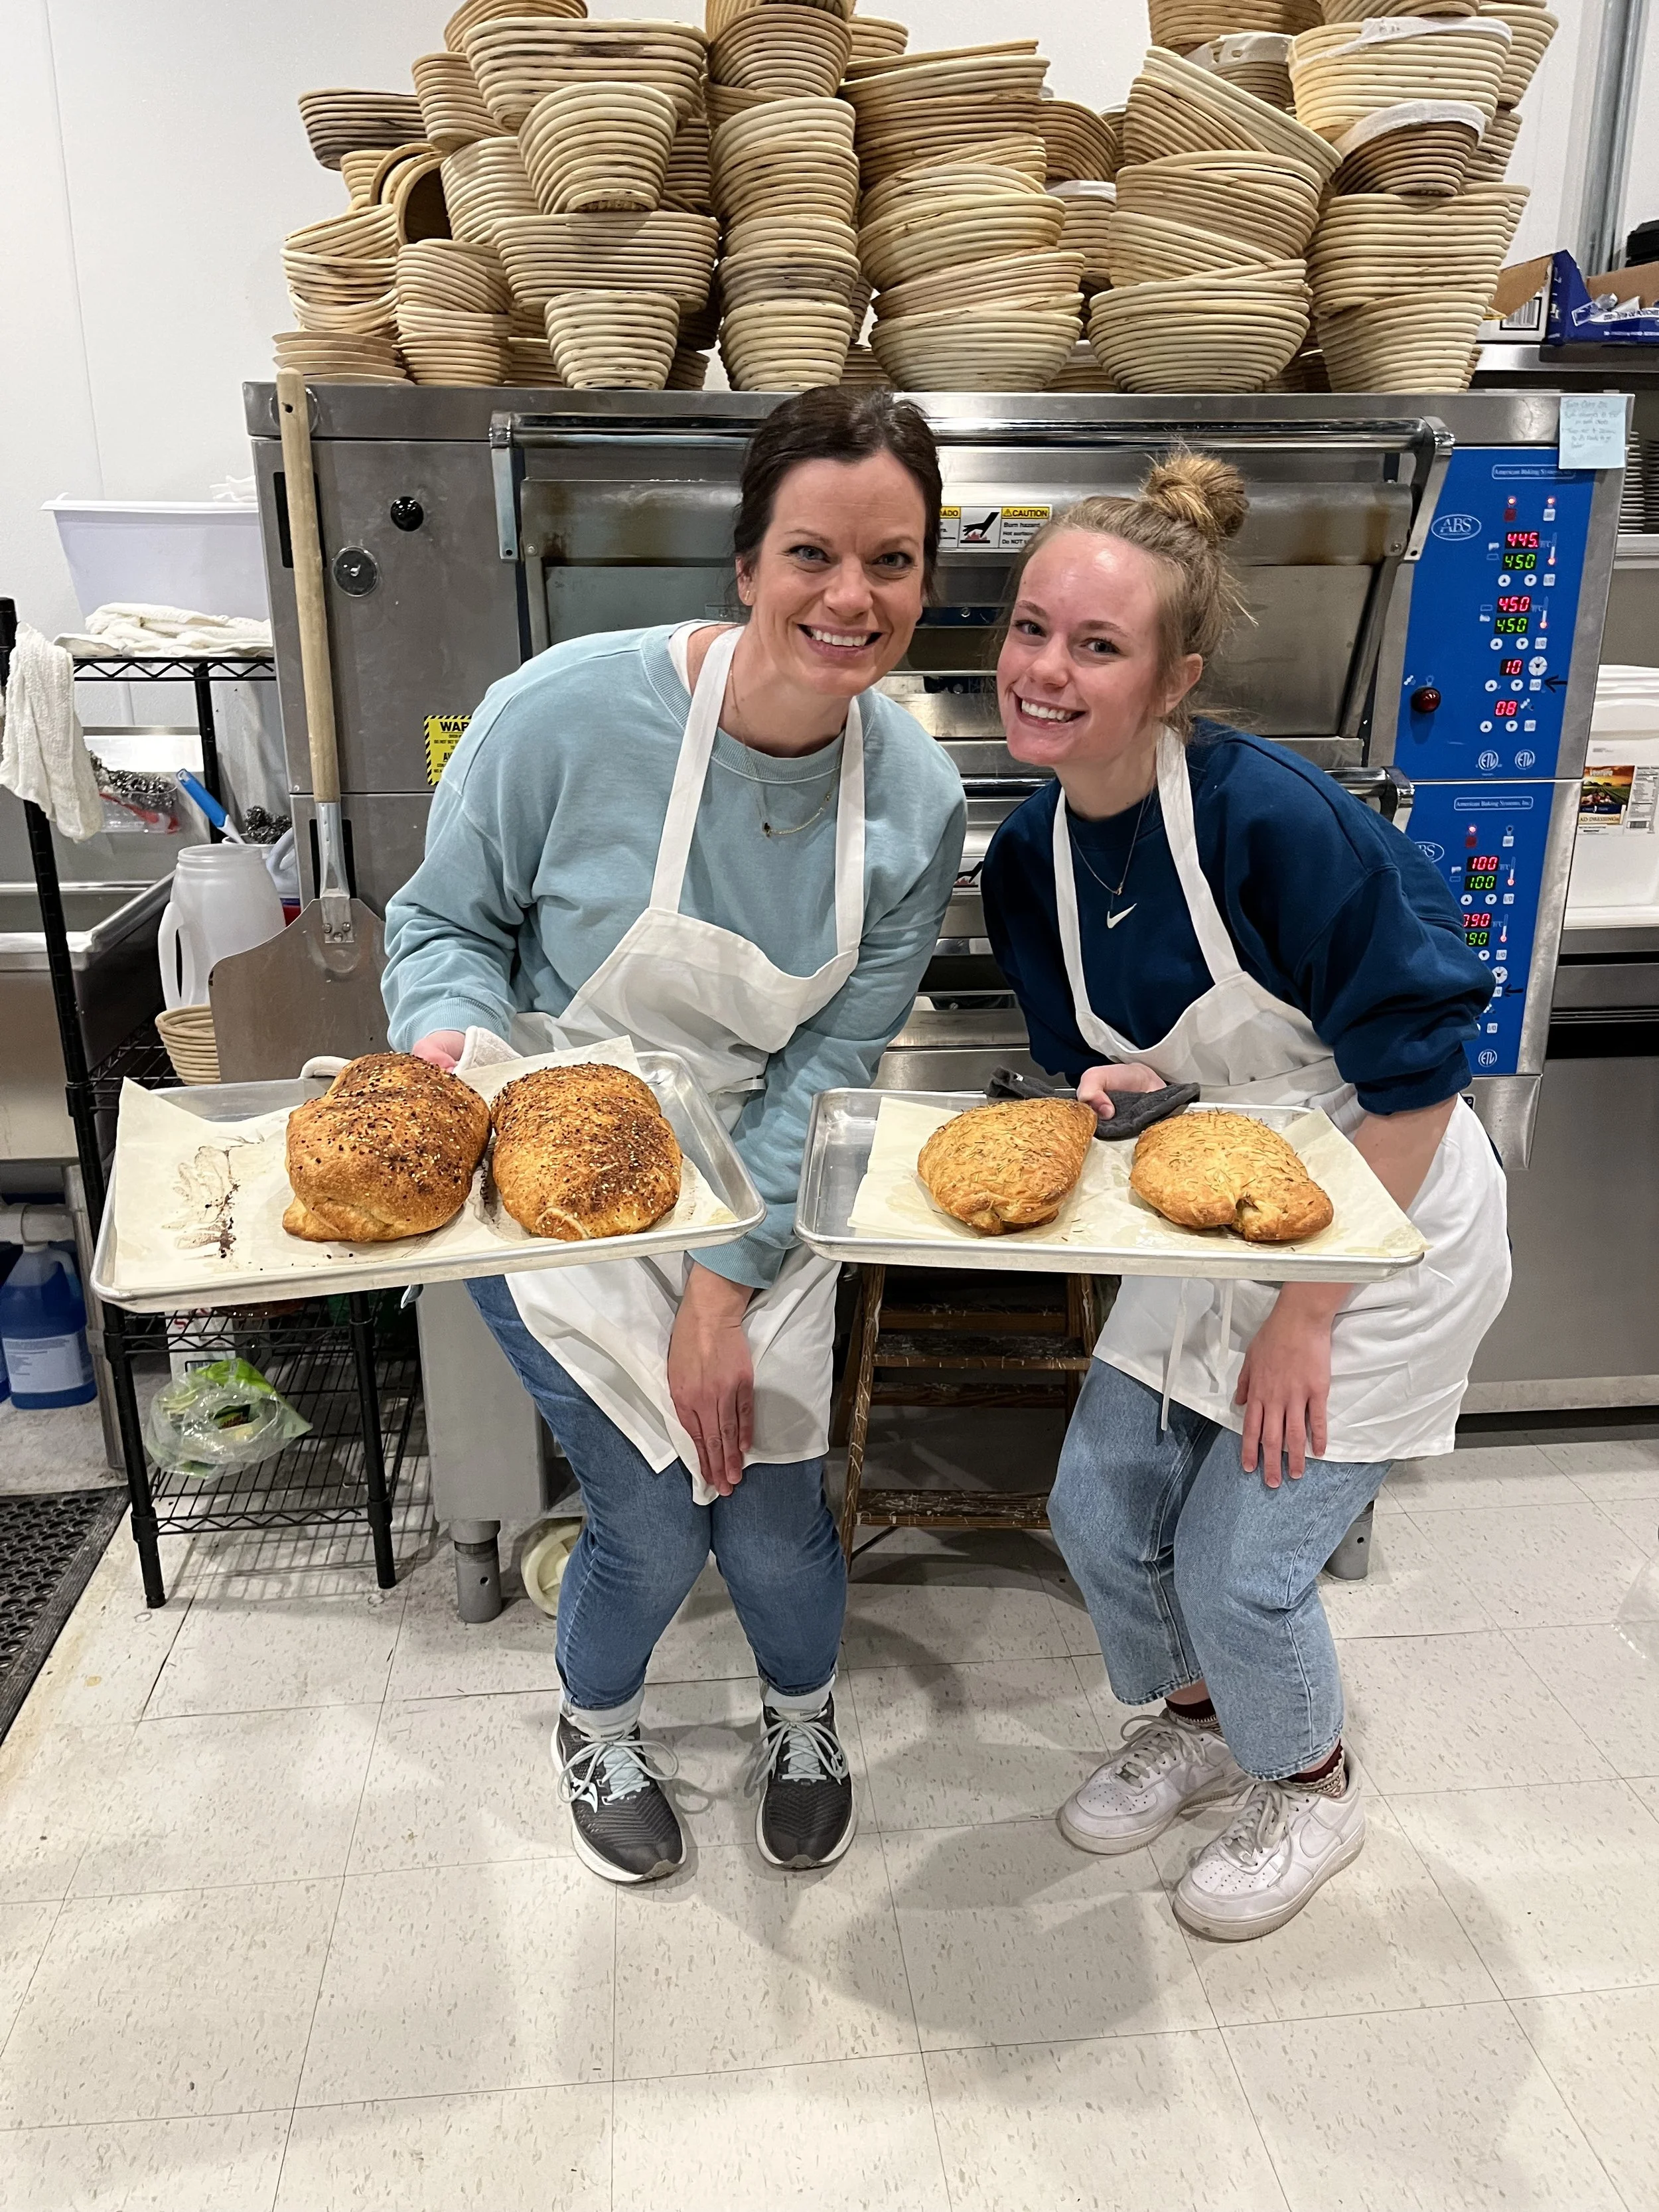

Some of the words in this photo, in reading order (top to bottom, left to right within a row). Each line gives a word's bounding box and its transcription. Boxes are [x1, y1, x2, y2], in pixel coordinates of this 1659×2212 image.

[1440, 517, 1472, 533] ABS
[1504, 553, 1536, 569] 450
[1498, 596, 1530, 612] 450
[1496, 617, 1528, 632] 450
[1506, 660, 1522, 674] 10
[1418, 844, 1435, 858] BS
[1472, 856, 1498, 871] 100
[1470, 875, 1495, 889] 100
[1466, 932, 1488, 945] 90
[1481, 1051, 1494, 1067] ETL
